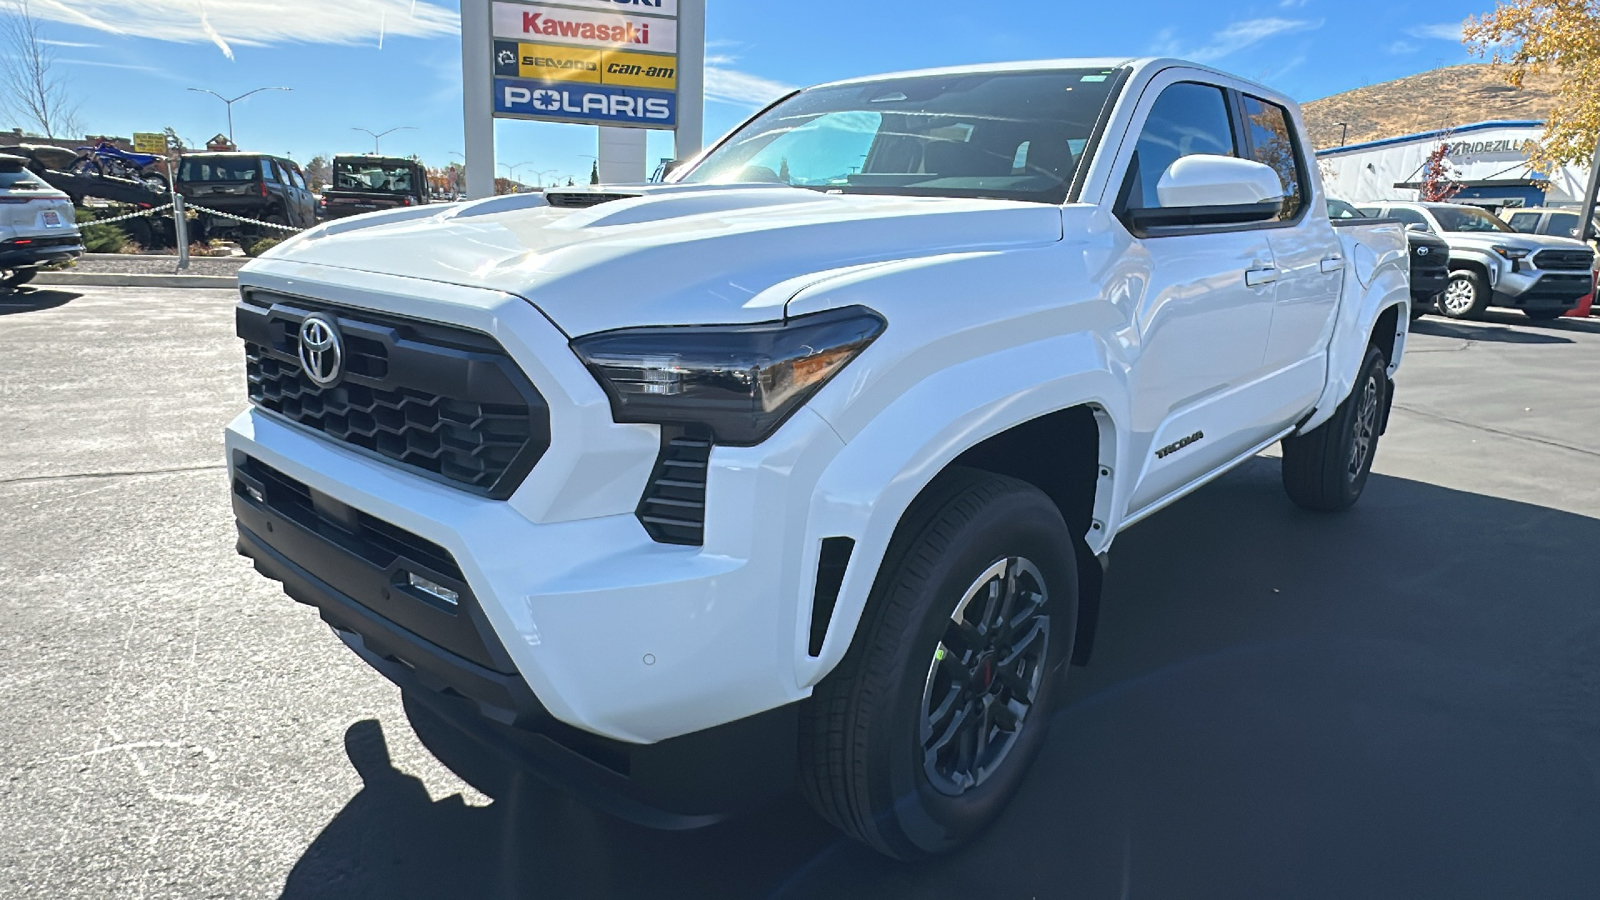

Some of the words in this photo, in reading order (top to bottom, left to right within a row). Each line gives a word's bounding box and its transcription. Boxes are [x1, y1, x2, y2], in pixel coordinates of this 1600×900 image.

[522, 11, 649, 44] Kawasaki
[504, 86, 670, 119] POLARIS
[1154, 430, 1204, 459] TACOMA
